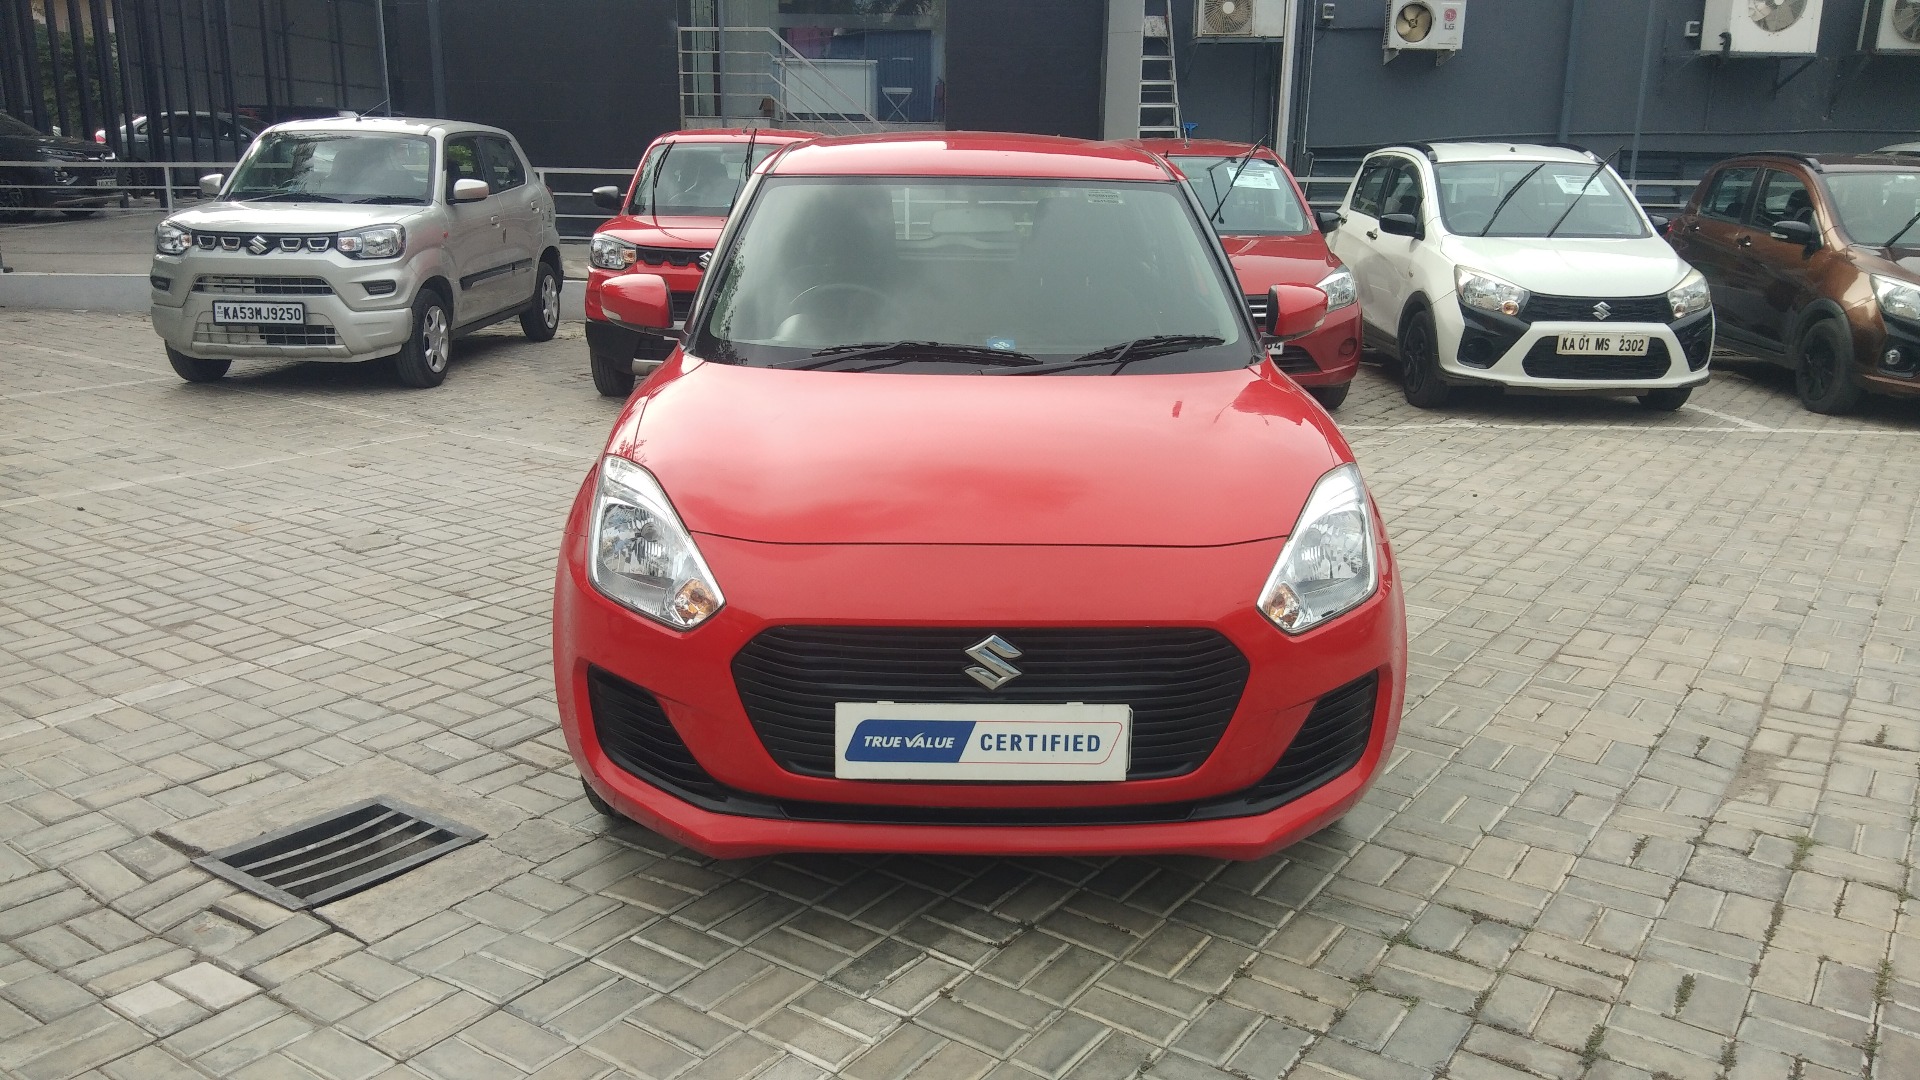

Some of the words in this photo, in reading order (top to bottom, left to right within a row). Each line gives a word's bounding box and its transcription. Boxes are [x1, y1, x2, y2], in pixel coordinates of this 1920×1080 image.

[223, 306, 301, 321] KA53MJ9250
[1561, 337, 1575, 351] KA
[1578, 337, 1590, 351] 01
[1594, 338, 1611, 351] MS
[1618, 338, 1645, 352] 2302
[864, 735, 903, 748] TRUE
[904, 731, 956, 749] VALUE
[980, 733, 1101, 752] CERTIFIED
